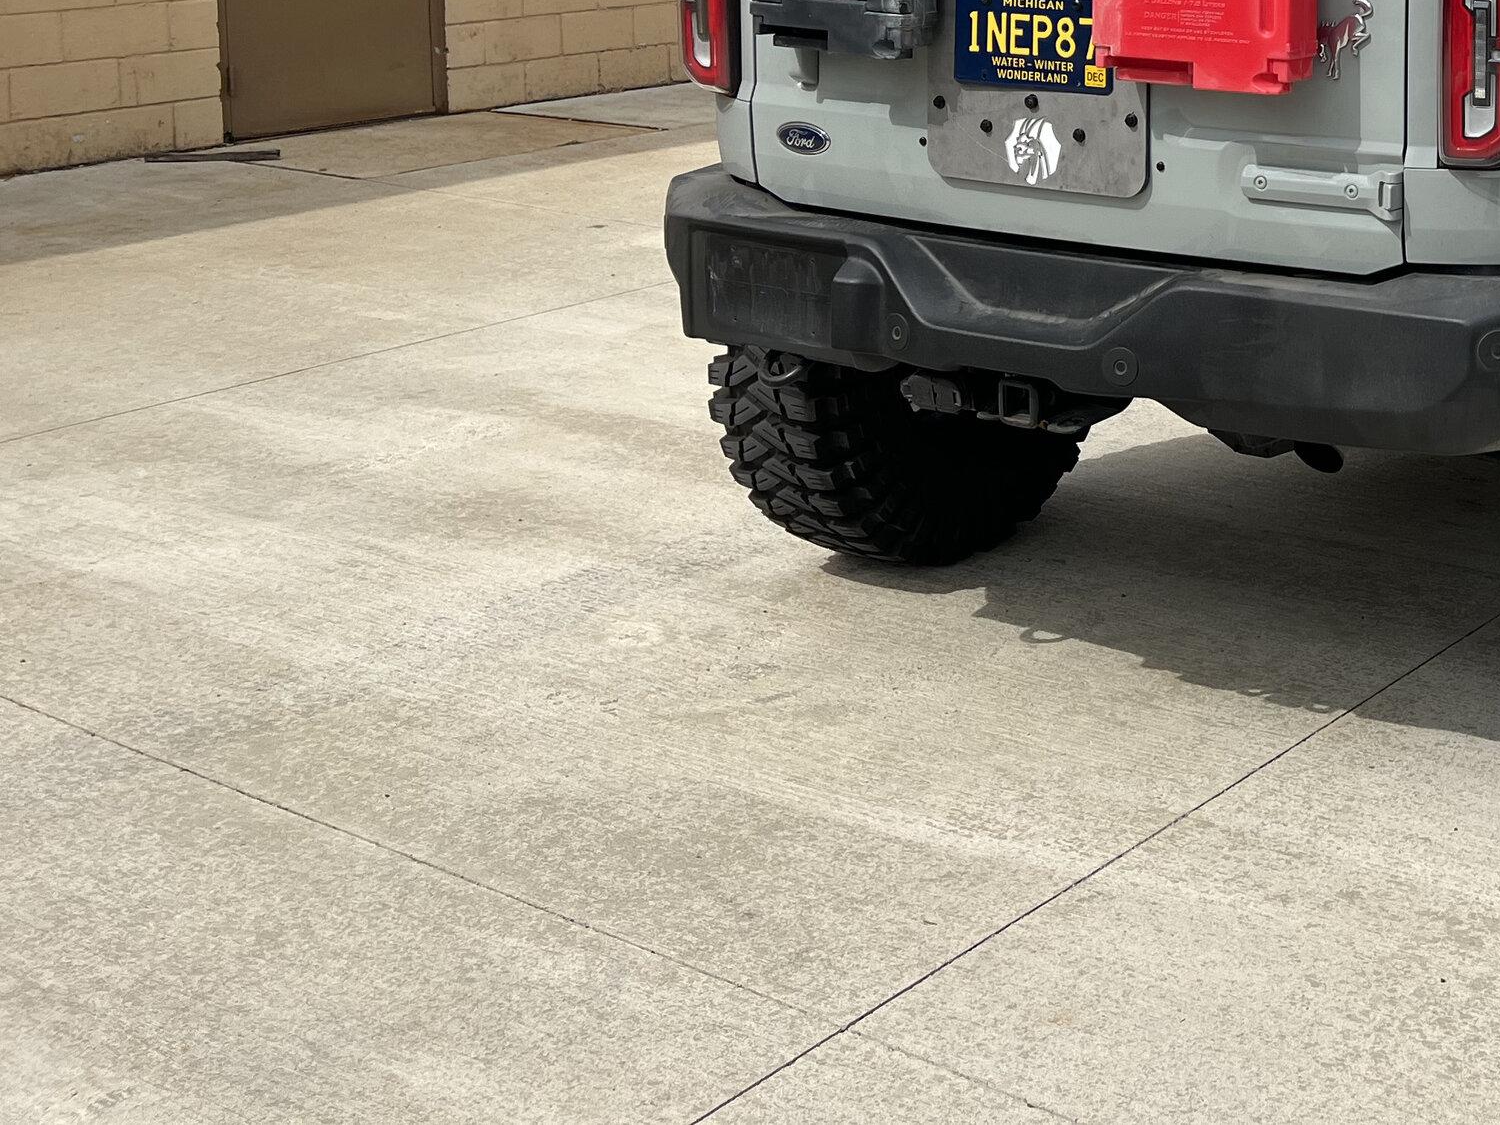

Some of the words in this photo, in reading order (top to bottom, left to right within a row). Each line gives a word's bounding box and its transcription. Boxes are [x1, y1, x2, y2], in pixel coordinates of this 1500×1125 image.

[1143, 10, 1177, 20] DANGER
[968, 10, 1095, 60] 1NEP87
[997, 69, 1068, 84] WONDERLAND
[1086, 71, 1104, 83] DEC
[786, 129, 815, 149] Ford
